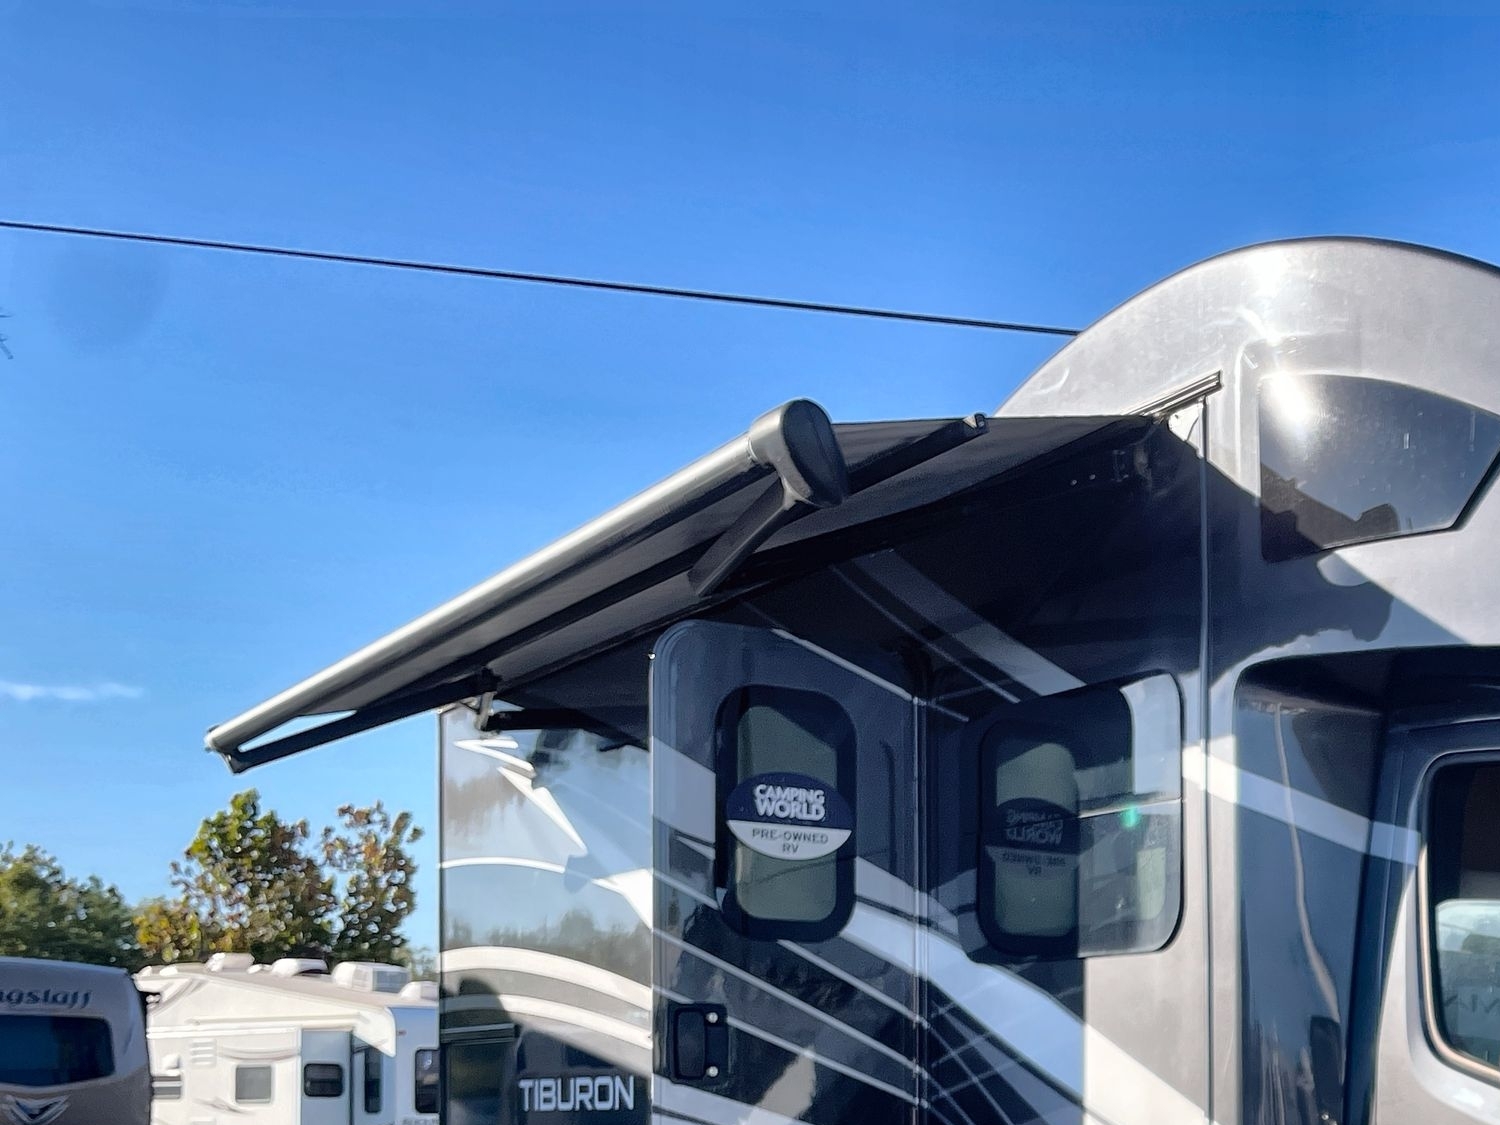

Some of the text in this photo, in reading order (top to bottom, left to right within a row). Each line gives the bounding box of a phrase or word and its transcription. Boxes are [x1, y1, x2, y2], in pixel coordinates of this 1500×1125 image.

[753, 783, 826, 805] CAMPING
[754, 798, 827, 821] WORLD
[751, 828, 829, 844] PRE-OWNED
[781, 842, 800, 853] RV
[0, 989, 92, 1009] gstaff
[518, 1075, 635, 1112] TIBURON
